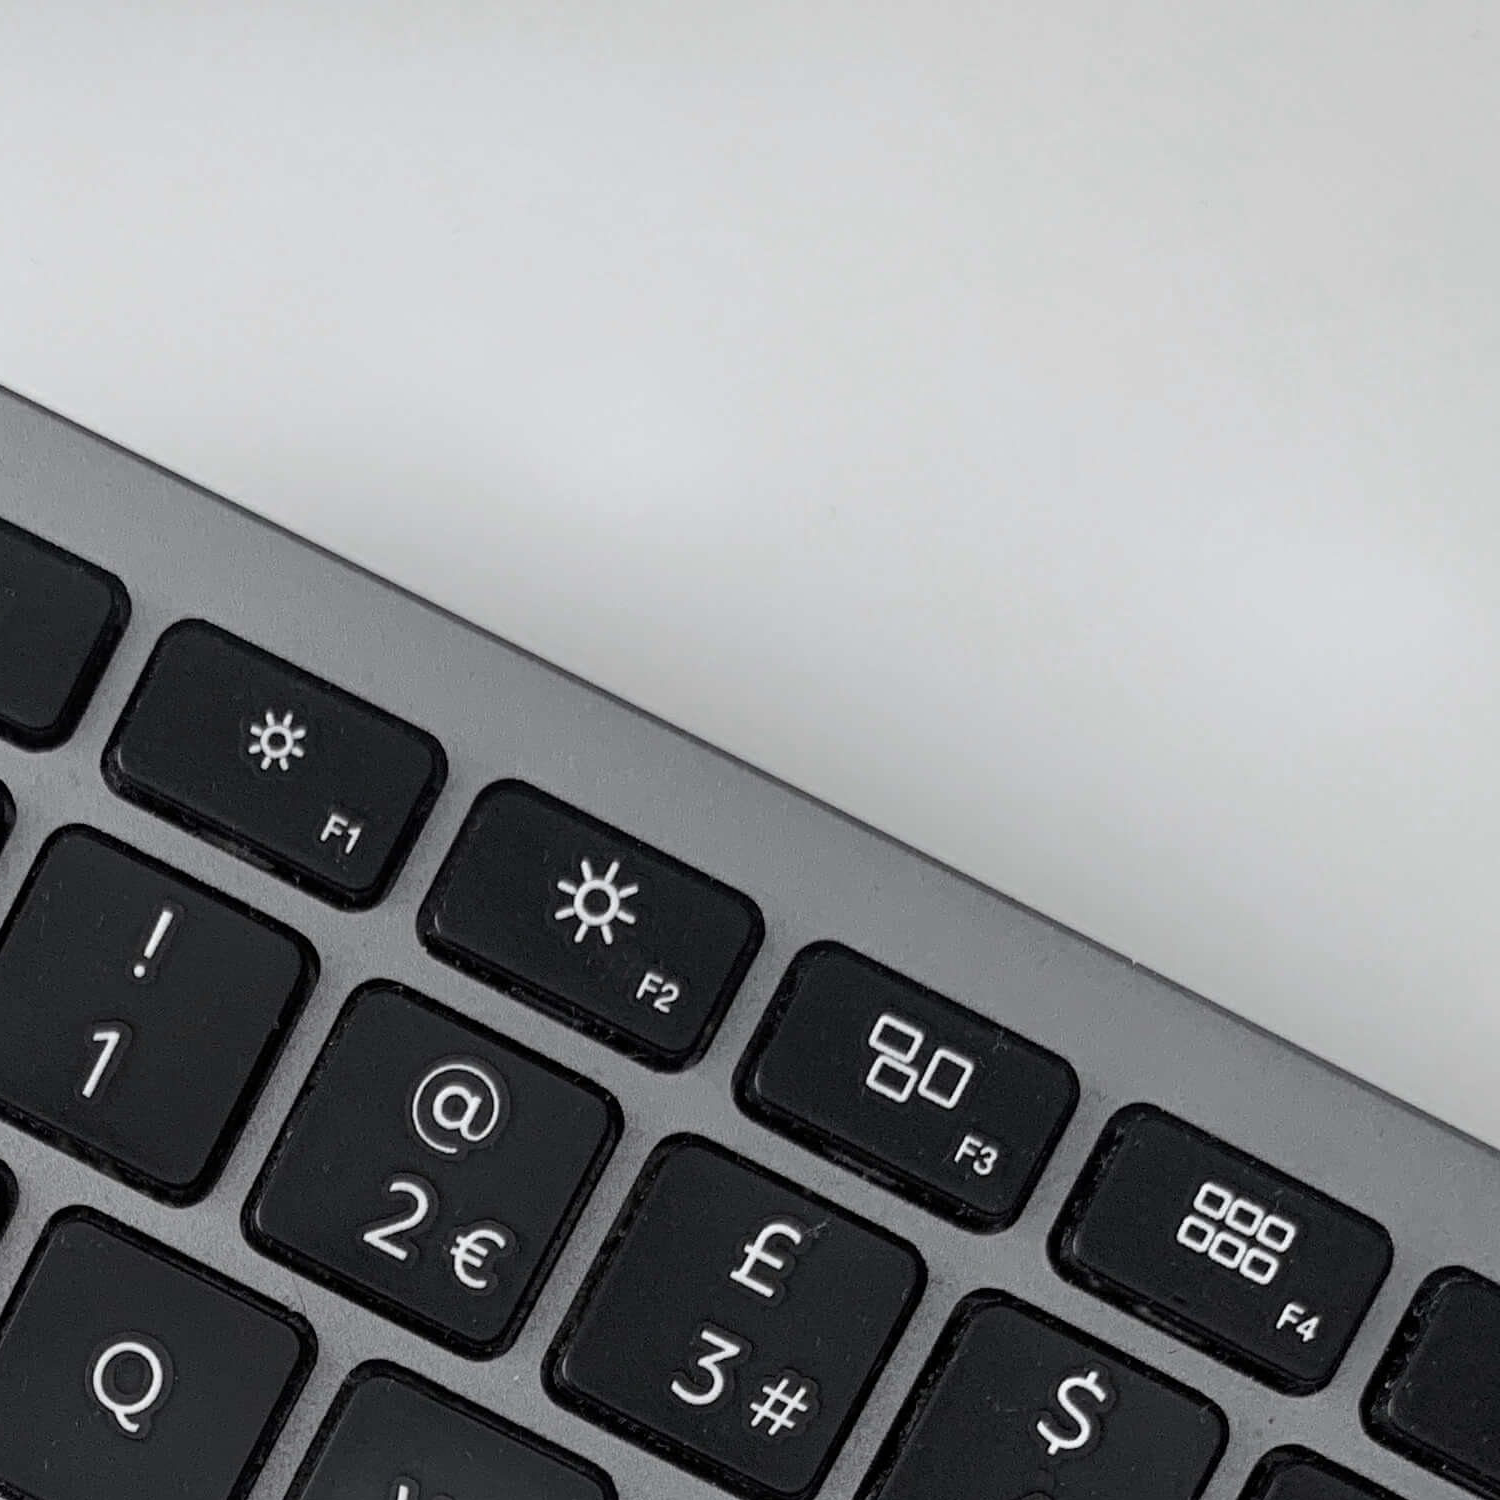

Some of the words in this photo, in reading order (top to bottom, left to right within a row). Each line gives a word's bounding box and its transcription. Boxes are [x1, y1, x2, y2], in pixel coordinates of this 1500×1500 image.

[320, 813, 361, 855] F1
[133, 909, 174, 978] !
[636, 972, 681, 1014] F2
[82, 1030, 121, 1099] 1
[412, 1063, 501, 1154] @
[954, 1134, 999, 1175] F3
[362, 1181, 430, 1261] 2
[449, 1228, 506, 1289] €
[729, 1222, 802, 1298] £
[1276, 1302, 1321, 1343] F4
[92, 1341, 164, 1433] Q
[671, 1330, 741, 1405] 3
[749, 1378, 809, 1436] #
[1036, 1371, 1107, 1455] $
